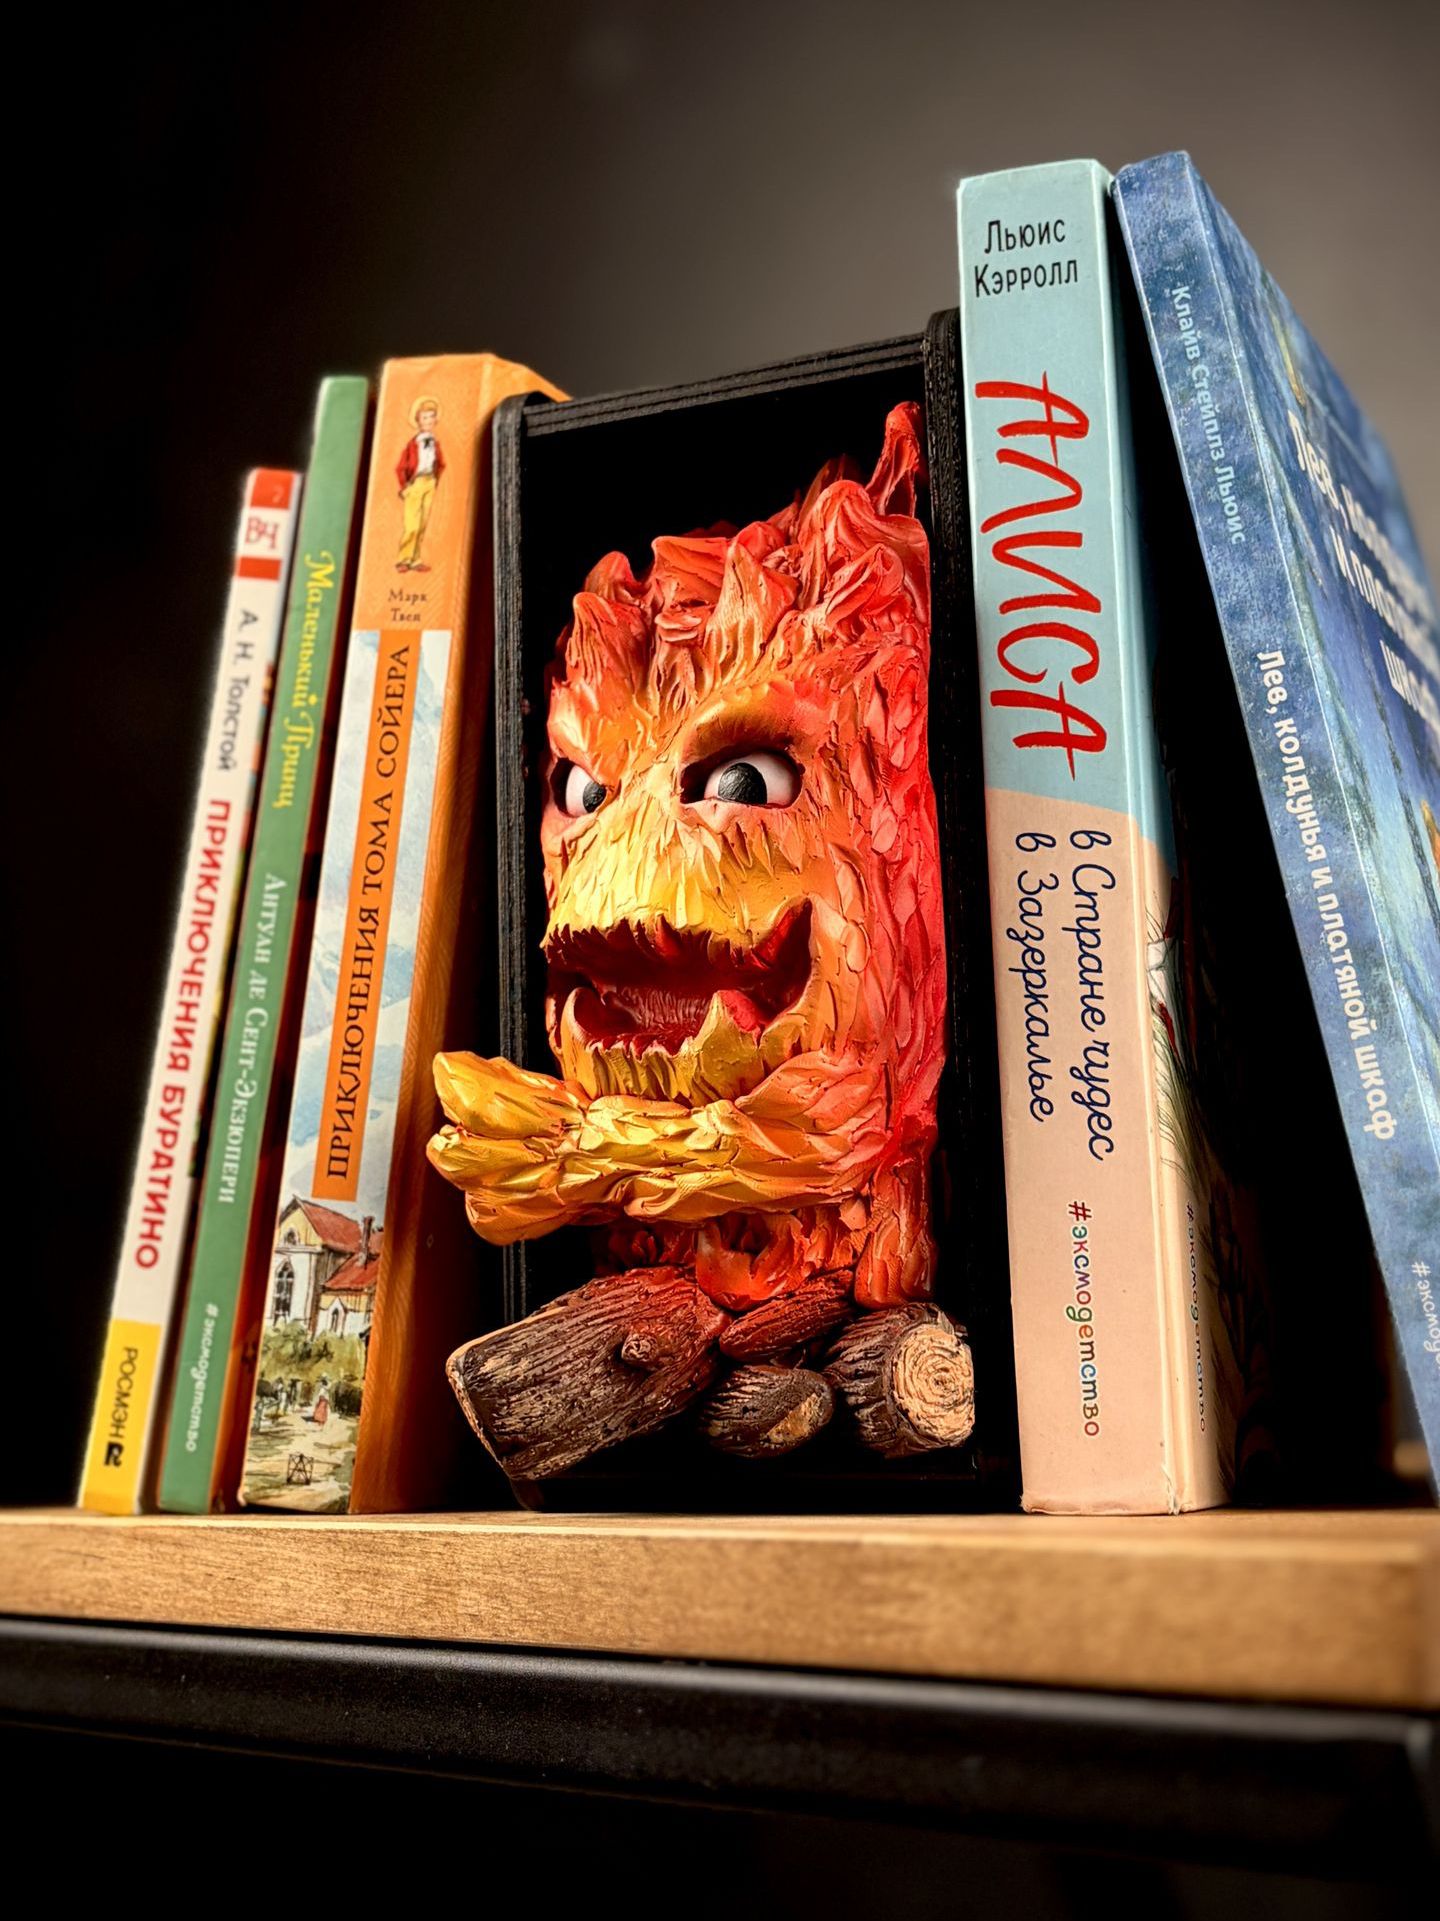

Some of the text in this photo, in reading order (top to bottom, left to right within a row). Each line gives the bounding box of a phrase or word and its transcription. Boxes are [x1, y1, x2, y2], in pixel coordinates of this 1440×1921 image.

[974, 259, 1078, 297] Кэрролл
[984, 219, 1066, 254] Льюис
[1171, 285, 1246, 545] Клайв Стейплз Льюис
[272, 550, 336, 808] Маленький Принц
[975, 371, 1107, 781] АЛИСА
[217, 676, 250, 771] Толстой
[327, 644, 410, 1180] ПРИКЛЮЧЕНИЯ ТОМА СОЙЕРА
[1006, 832, 1061, 1123] в Зазеркалье
[1062, 830, 1117, 1162] в Стране чудес
[1256, 650, 1398, 1141] Лев, колдунья и платяной шкаф
[135, 798, 231, 1269] ПРИКЛЮЧЕНИЯ БУРАТИНО
[108, 1346, 139, 1439] РОСМЭН
